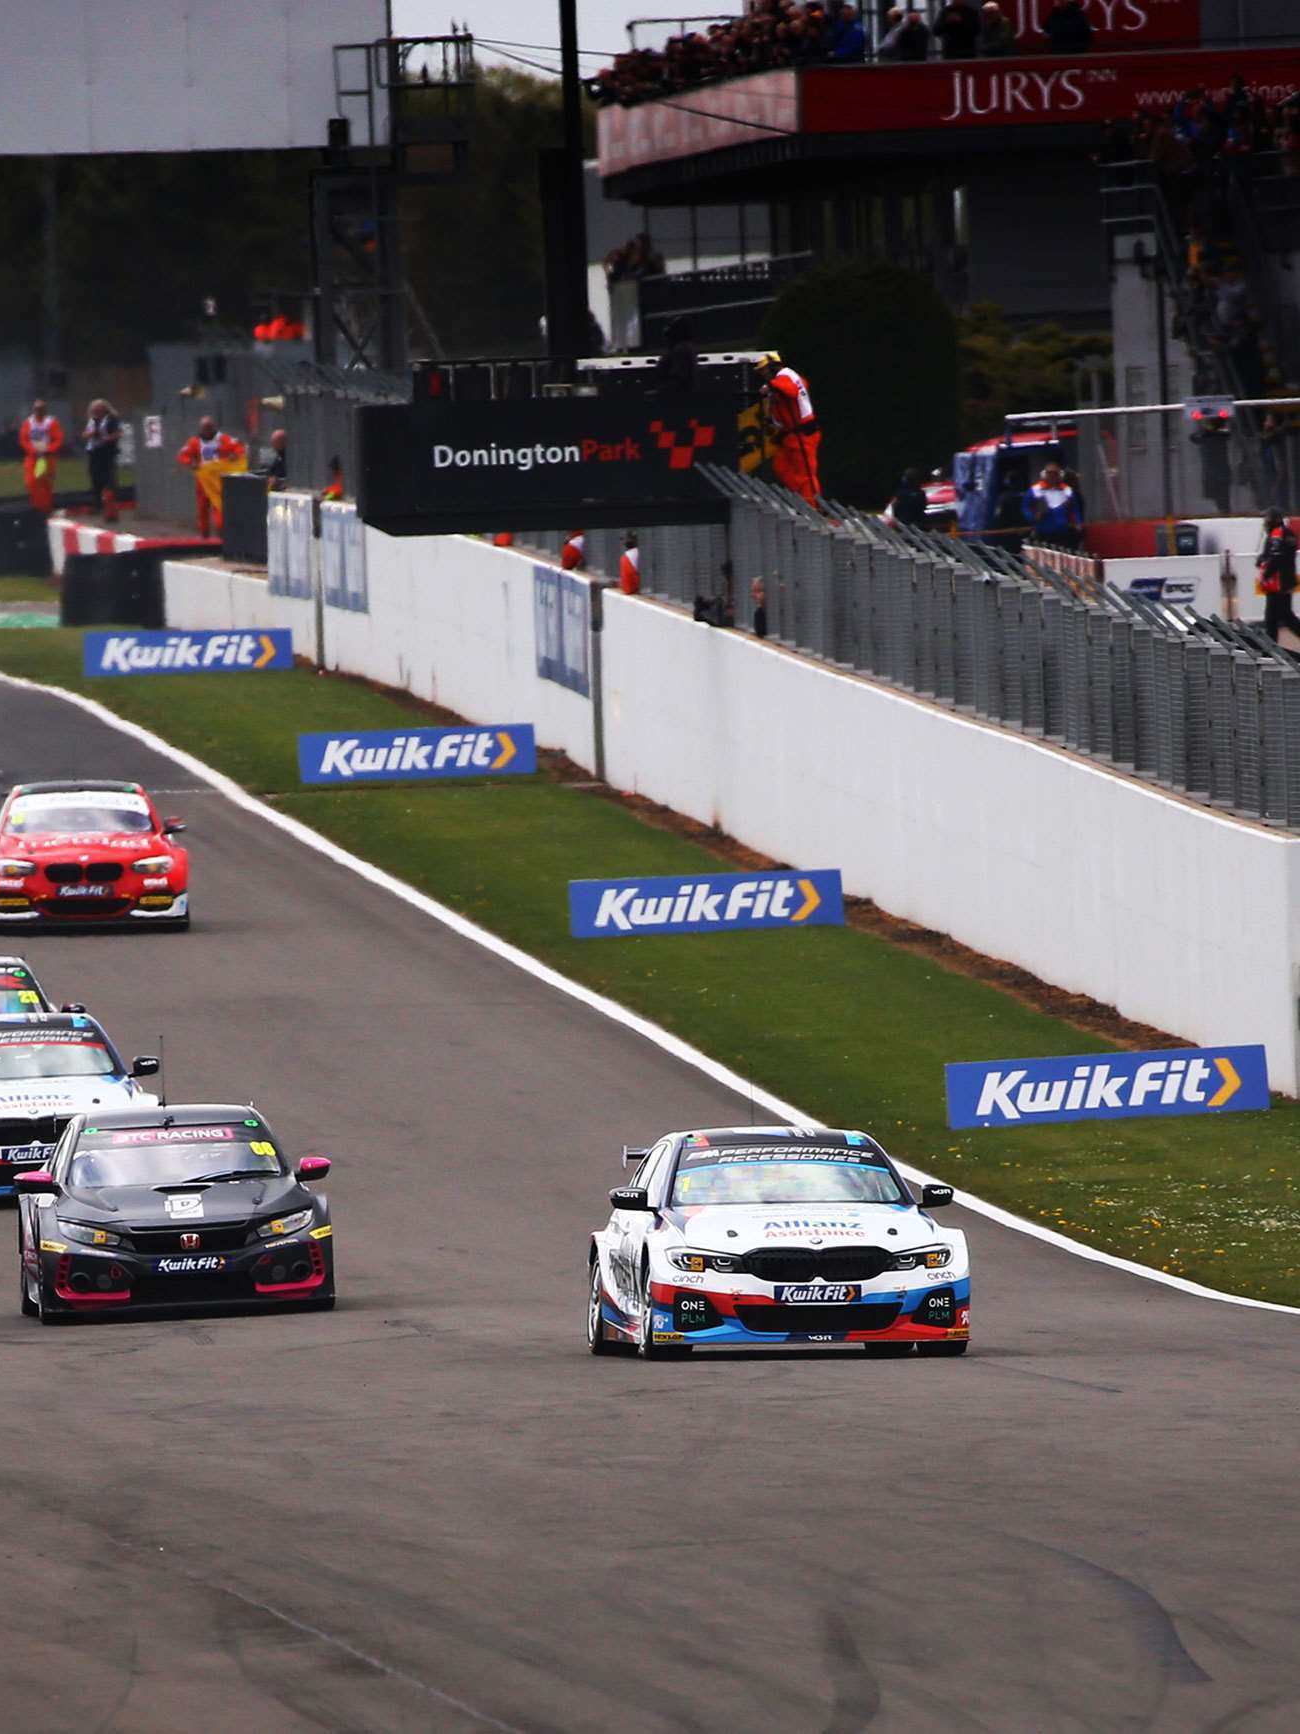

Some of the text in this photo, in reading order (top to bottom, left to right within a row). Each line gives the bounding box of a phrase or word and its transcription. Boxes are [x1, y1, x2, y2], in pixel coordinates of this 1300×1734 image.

[940, 69, 1085, 121] JURYS
[156, 1128, 224, 1140] RACING
[718, 1146, 875, 1159] PERFORMANCE
[717, 1153, 862, 1164] ACCESSORIES
[763, 1219, 864, 1231] Allianz
[764, 1229, 866, 1239] Assistance
[672, 1272, 704, 1284] cinch
[927, 1270, 957, 1281] cinch
[680, 1300, 706, 1311] ONE
[928, 1297, 950, 1308] ONE
[680, 1313, 706, 1324] PLM
[928, 1311, 950, 1320] PLM
